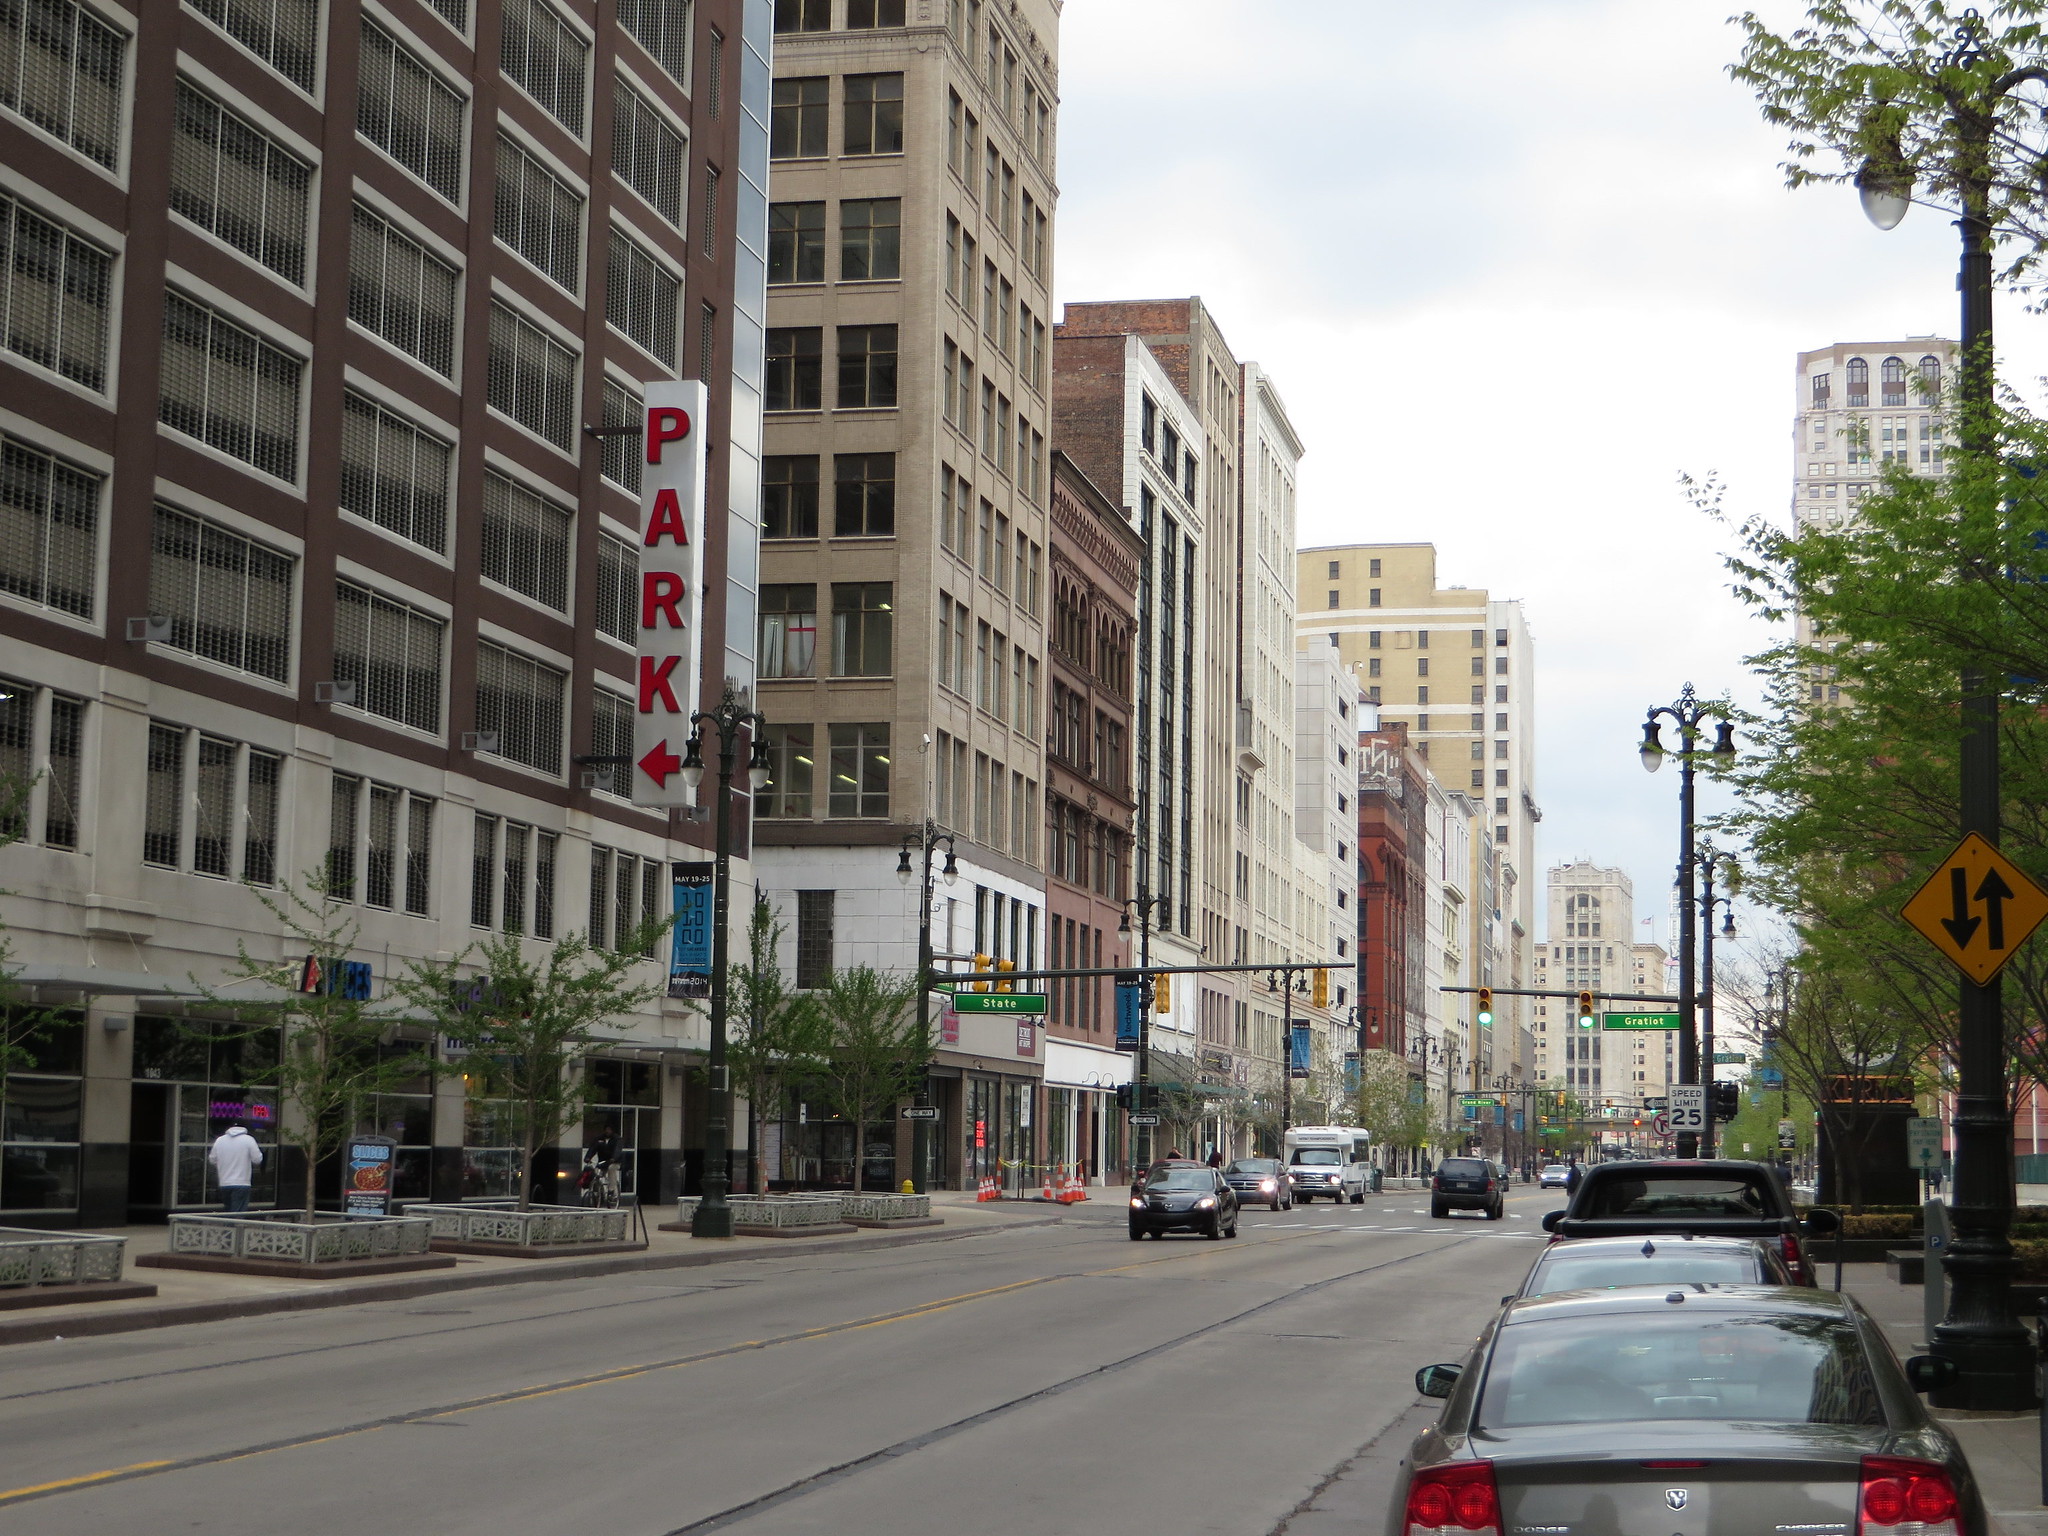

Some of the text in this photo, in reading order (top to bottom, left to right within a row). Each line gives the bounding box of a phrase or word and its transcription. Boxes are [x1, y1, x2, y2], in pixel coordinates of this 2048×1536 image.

[639, 407, 691, 713] PARK
[691, 875, 711, 883] 19-25
[982, 998, 1017, 1008] State
[1124, 991, 1132, 1033] techweek
[1624, 1016, 1664, 1026] Gratiot
[1670, 1089, 1702, 1097] SPEED
[1674, 1099, 1698, 1107] LIMIT
[1671, 1108, 1702, 1126] 25
[353, 1145, 390, 1159] SLICES
[1931, 1236, 1940, 1247] P
[1513, 1526, 1568, 1534] DODGE
